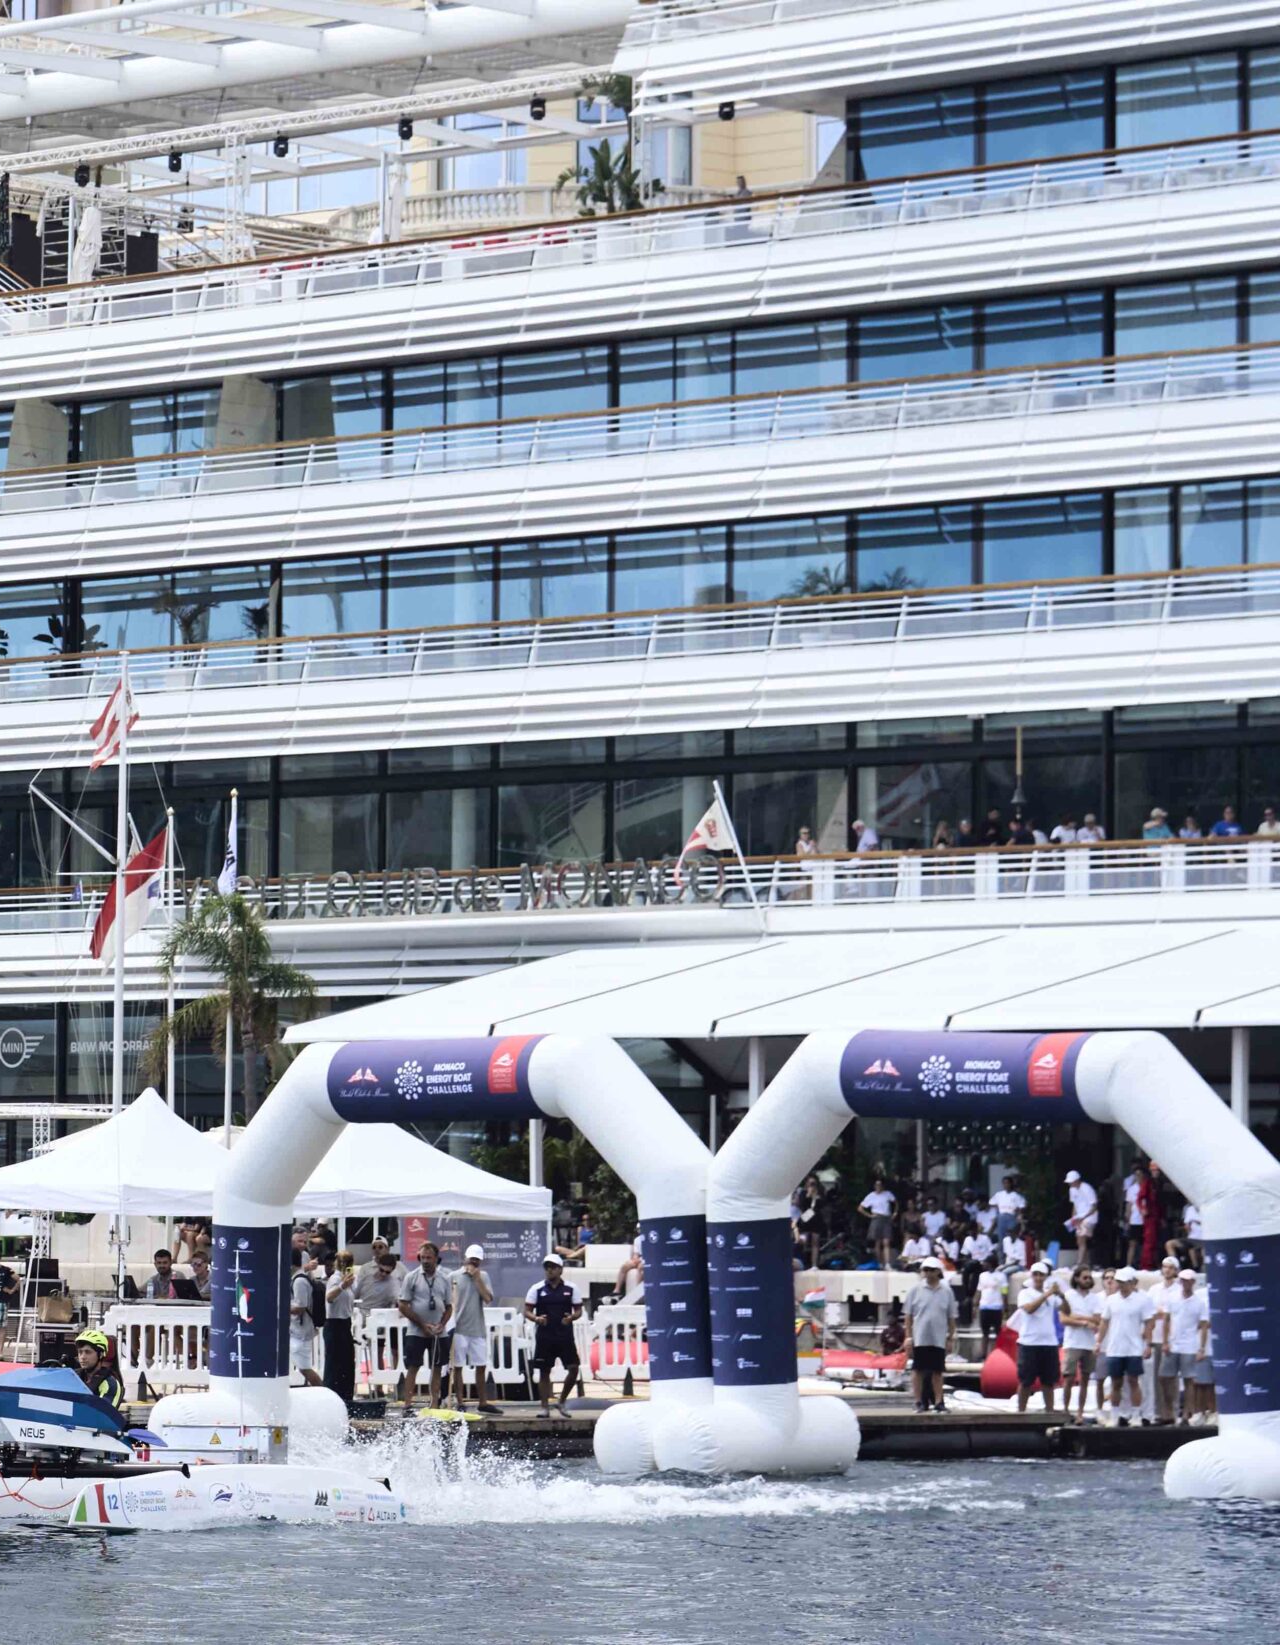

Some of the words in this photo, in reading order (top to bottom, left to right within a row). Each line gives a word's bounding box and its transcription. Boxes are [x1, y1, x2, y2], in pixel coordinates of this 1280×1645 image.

[327, 867, 442, 917] CLUB
[454, 864, 503, 912] de
[520, 853, 725, 908] MONACO
[2, 1042, 23, 1053] MINI
[70, 1041, 96, 1052] BMW
[98, 1041, 156, 1051] MOORRA
[433, 1061, 466, 1072] MONACO
[964, 1060, 1002, 1070] MONACO
[426, 1073, 453, 1085] ENERGY
[453, 1072, 473, 1083] BOAT
[955, 1072, 986, 1083] ENERGY
[987, 1072, 1010, 1083] BOAT
[427, 1083, 474, 1095] CHALLENGE
[955, 1084, 1011, 1095] CHALLENGE
[19, 1427, 45, 1439] NEUS
[106, 1494, 119, 1510] 12
[376, 1511, 397, 1521] ALTAIR
